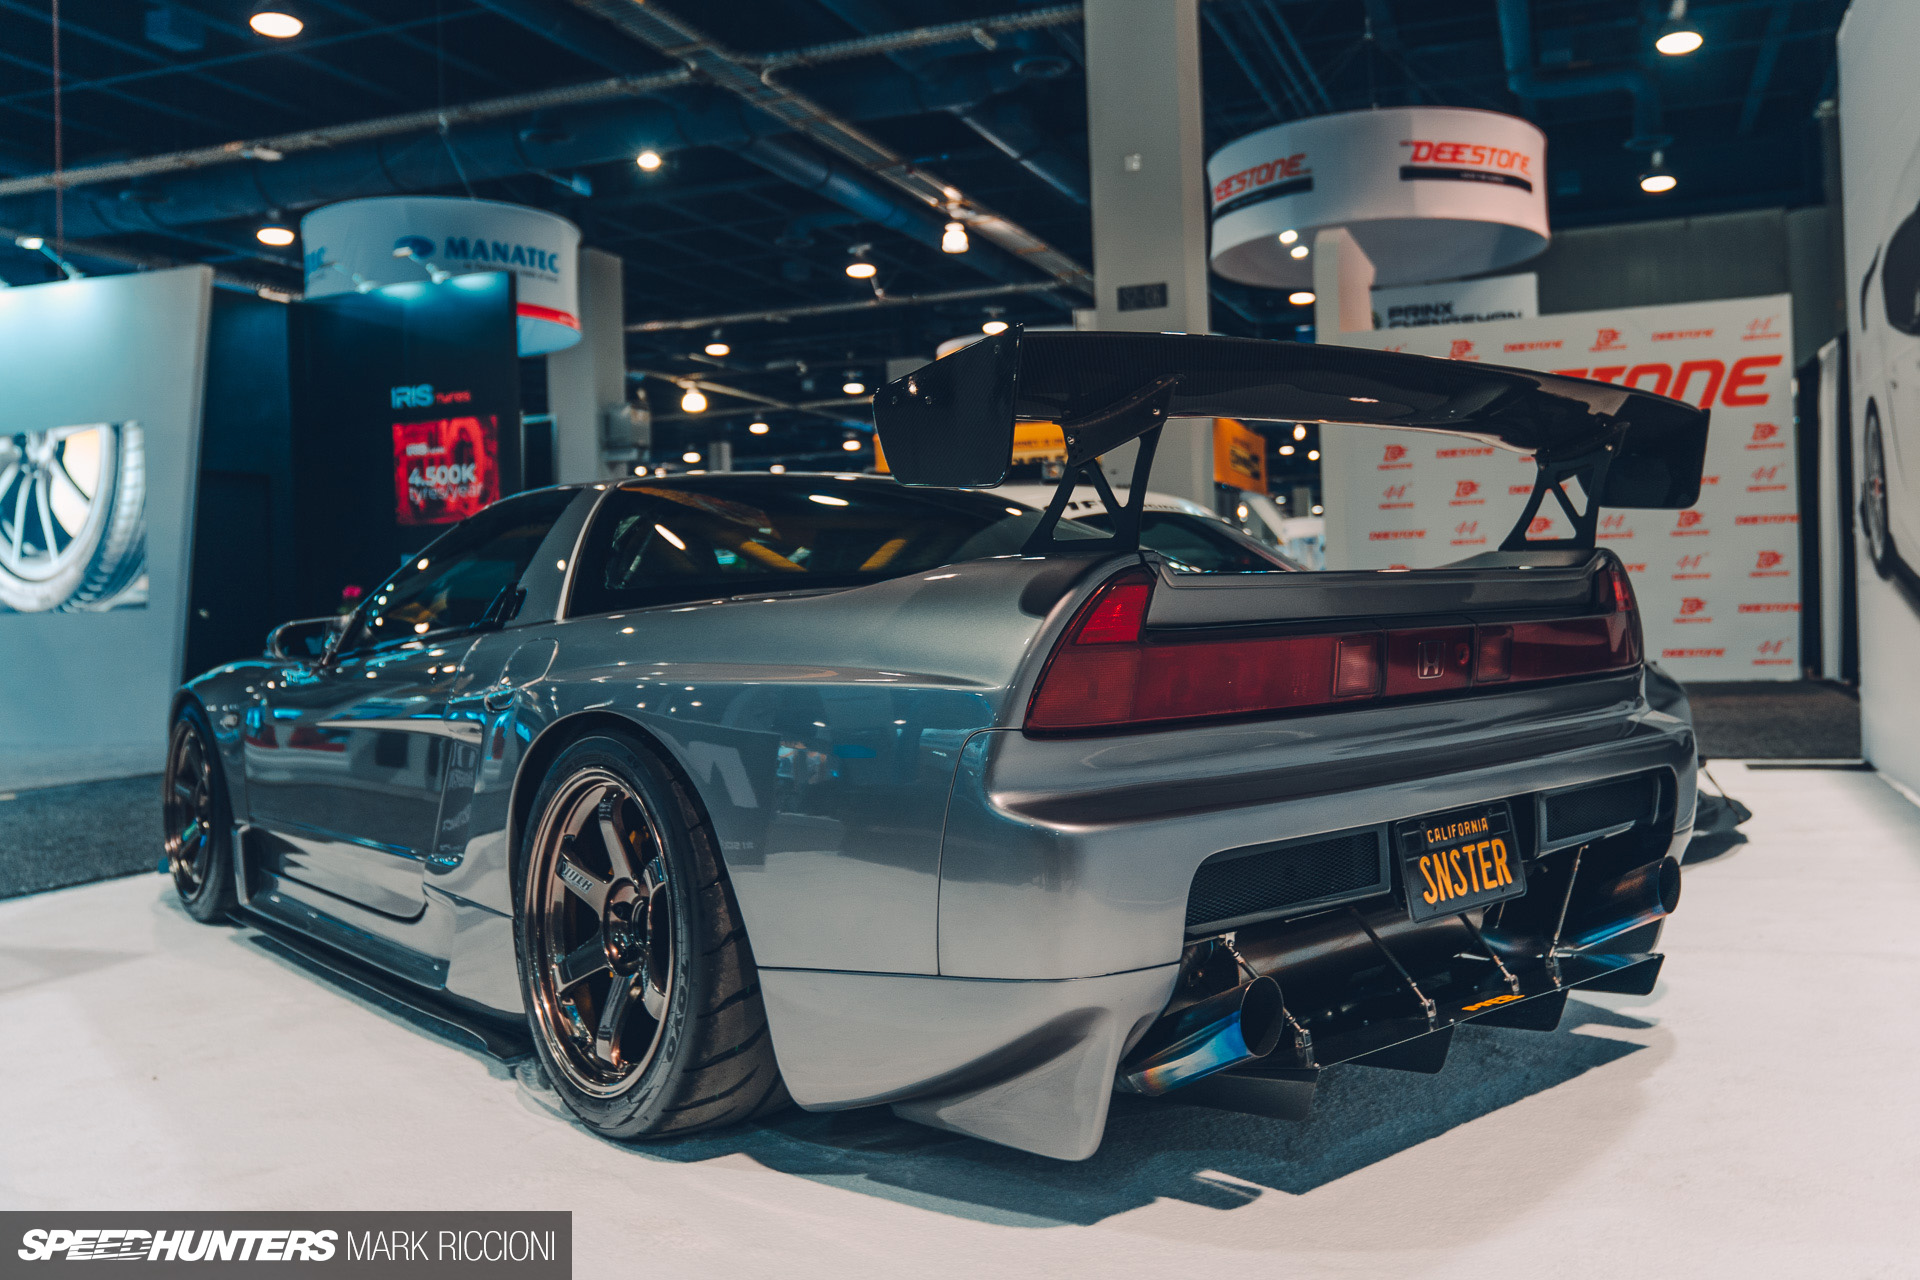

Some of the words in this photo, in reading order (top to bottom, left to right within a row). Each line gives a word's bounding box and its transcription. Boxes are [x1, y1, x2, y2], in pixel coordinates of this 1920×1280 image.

[1399, 140, 1531, 176] DEESTONE
[1214, 153, 1310, 202] EESTONE
[443, 236, 559, 274] MANATEC
[391, 384, 434, 409] IRIS
[1426, 817, 1489, 844] CALIFORNIA
[1419, 838, 1513, 904] SNSTER
